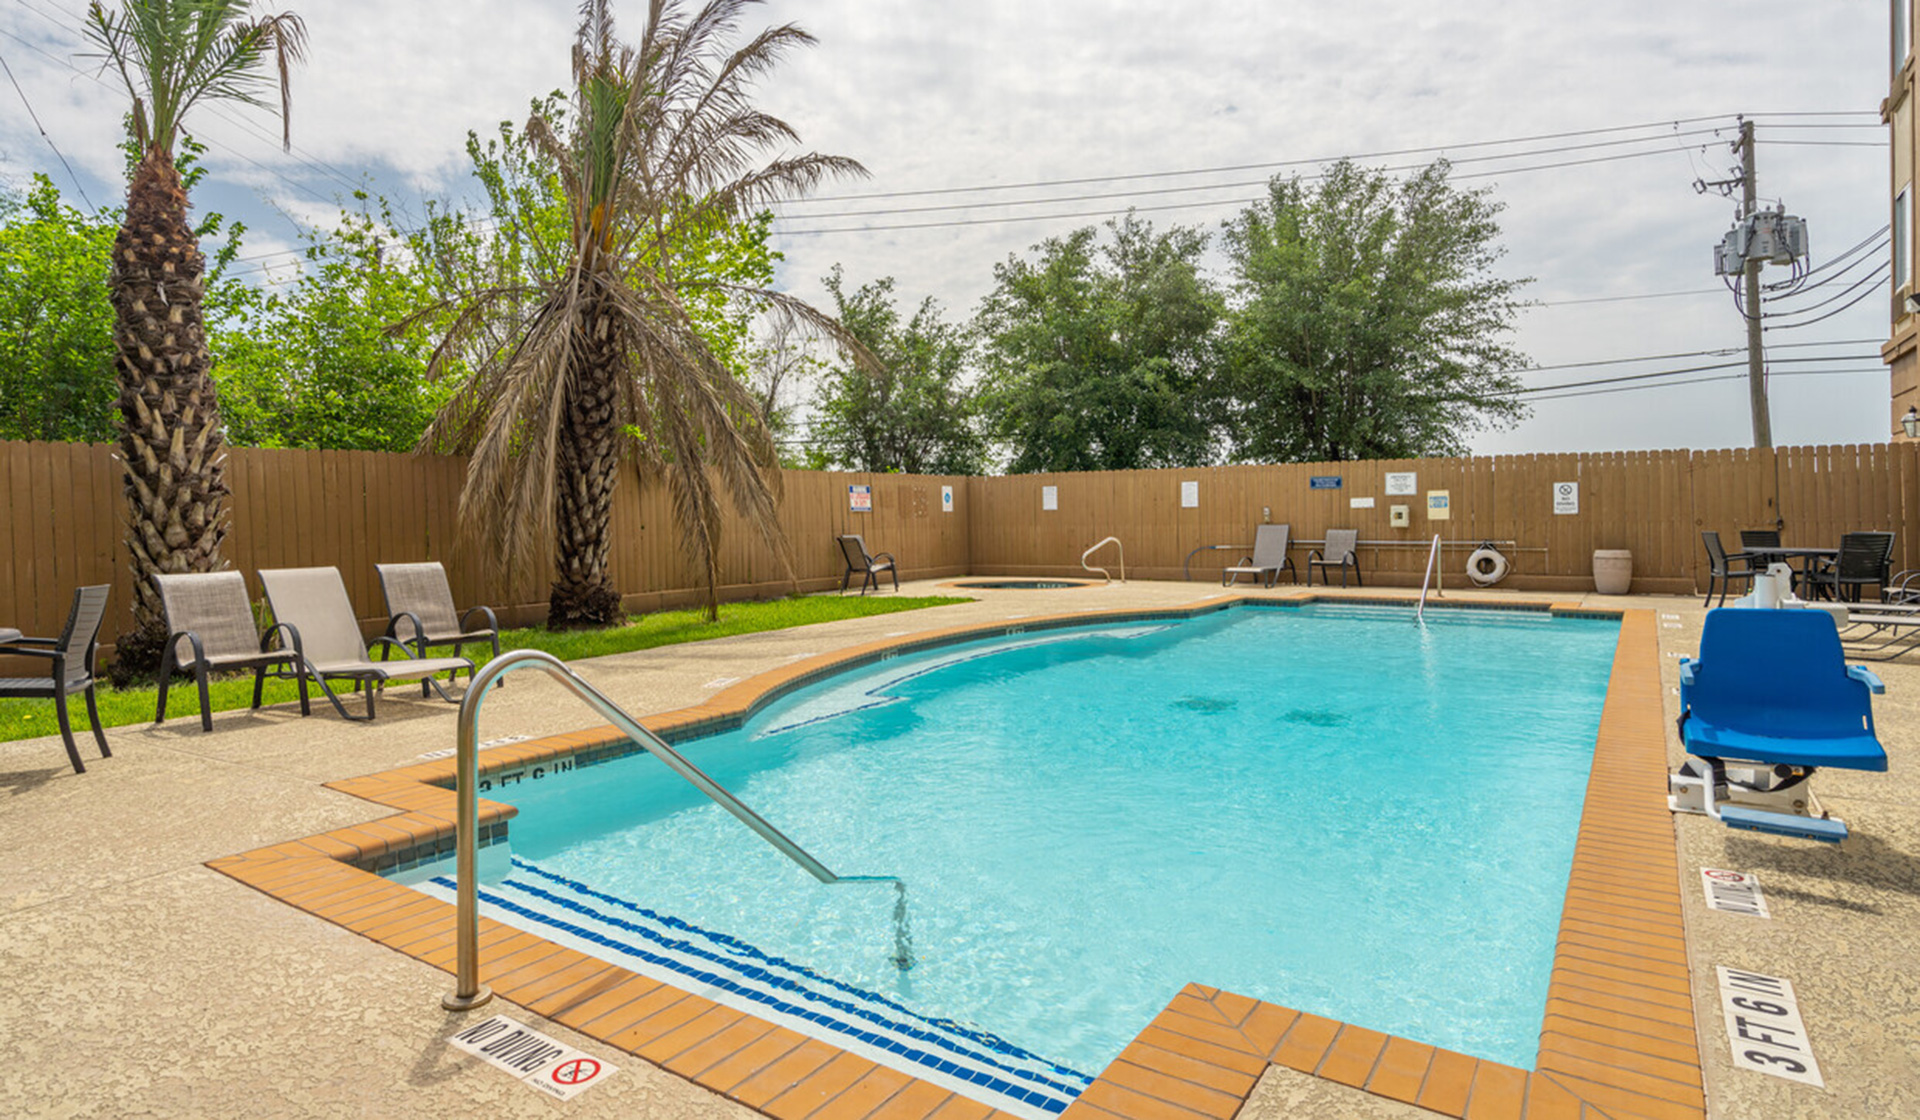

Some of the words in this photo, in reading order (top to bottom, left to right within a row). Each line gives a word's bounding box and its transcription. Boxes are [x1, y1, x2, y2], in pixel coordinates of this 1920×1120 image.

[501, 771, 524, 787] FT
[555, 760, 572, 774] IN
[1726, 969, 1784, 997] IN
[1732, 996, 1788, 1016] 6
[454, 1018, 509, 1045] NO
[1735, 1015, 1801, 1051] FT
[479, 1030, 563, 1073] DIVING
[1743, 1050, 1807, 1074] 3
